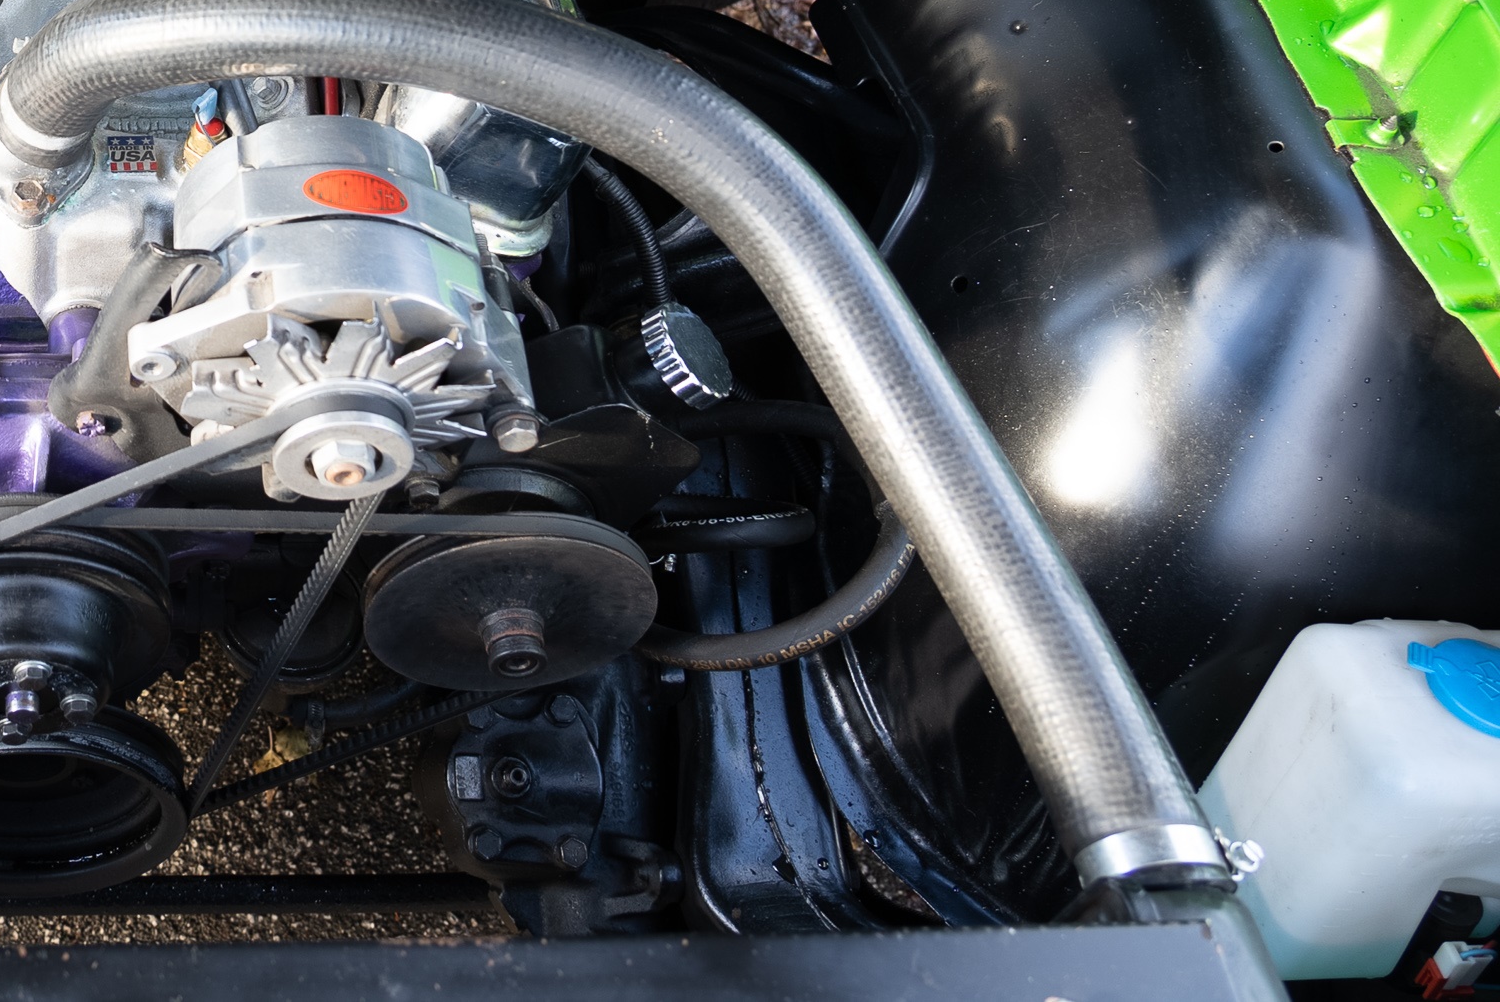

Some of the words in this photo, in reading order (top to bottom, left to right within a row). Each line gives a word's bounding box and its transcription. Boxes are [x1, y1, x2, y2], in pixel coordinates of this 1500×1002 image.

[110, 150, 156, 162] USA
[690, 659, 723, 670] 2SN
[725, 657, 753, 669] DN
[757, 652, 778, 665] 10
[780, 629, 836, 659] MSHA
[897, 543, 915, 569] ITA
